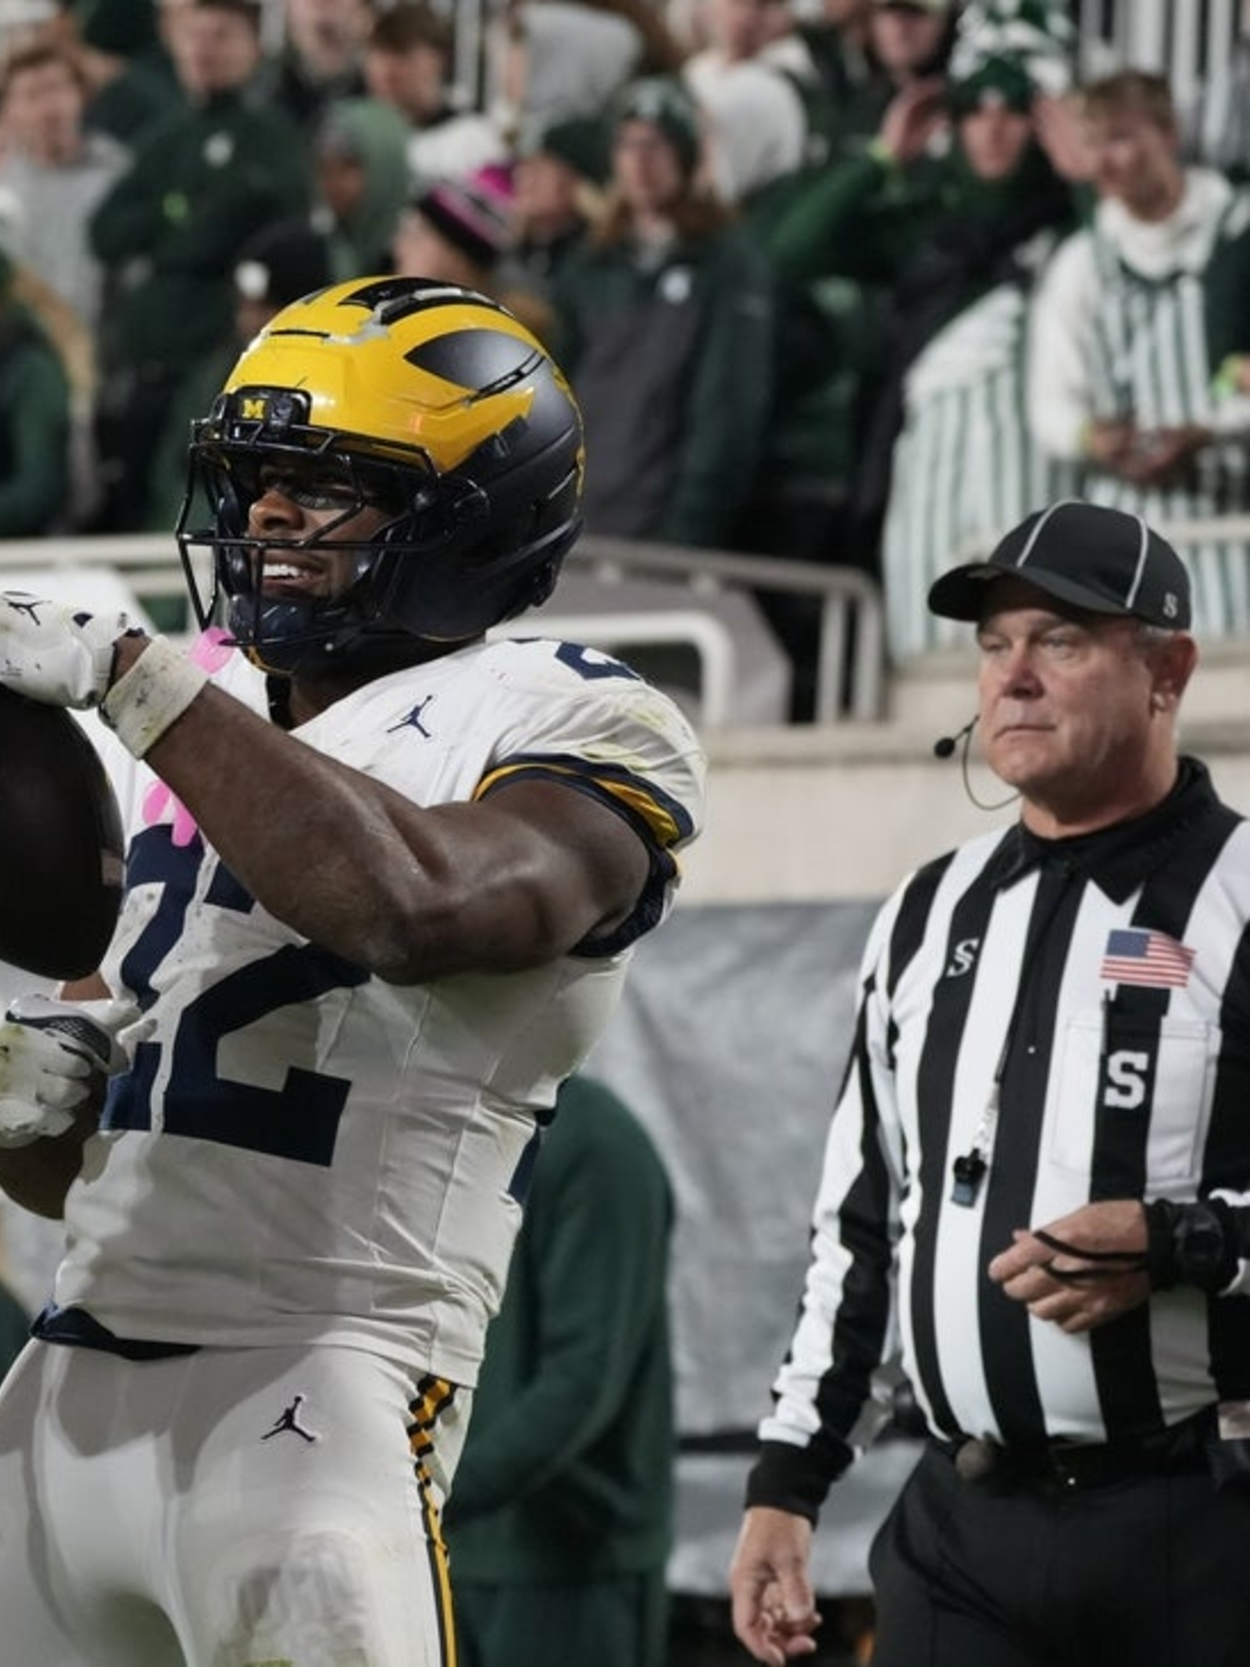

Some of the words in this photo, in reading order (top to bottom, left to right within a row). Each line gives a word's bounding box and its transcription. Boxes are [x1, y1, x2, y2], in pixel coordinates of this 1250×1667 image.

[241, 399, 265, 419] M
[946, 937, 980, 977] S
[1103, 1050, 1149, 1110] S
